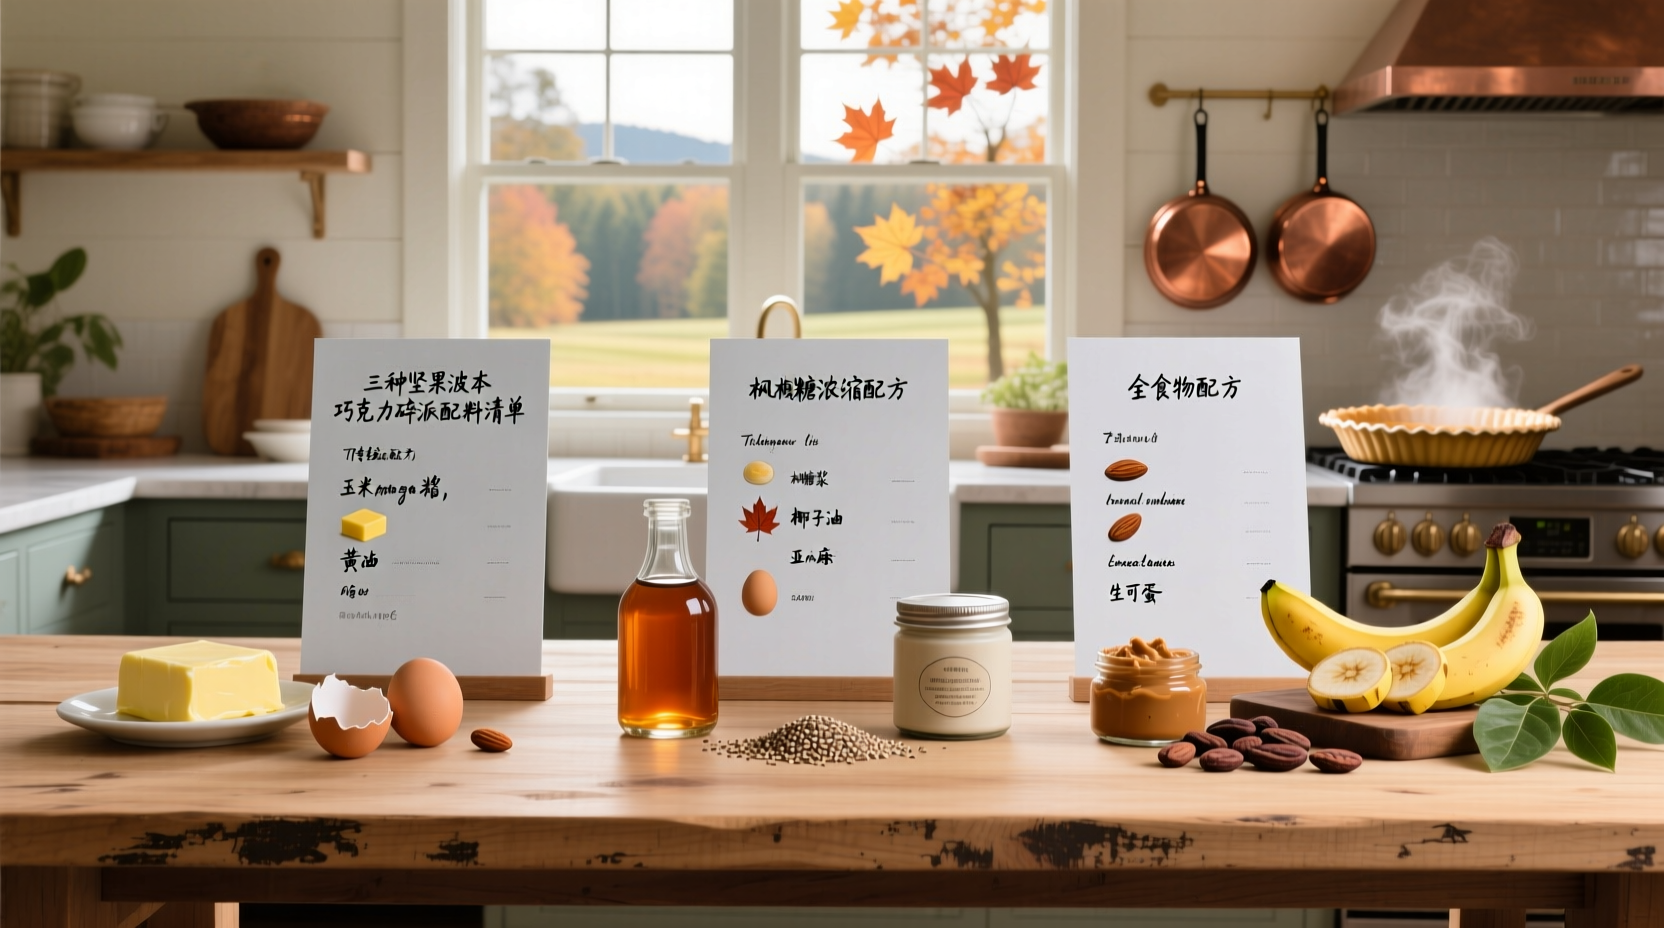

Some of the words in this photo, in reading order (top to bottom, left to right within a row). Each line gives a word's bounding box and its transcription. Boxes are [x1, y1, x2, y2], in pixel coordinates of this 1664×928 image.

[363, 370, 492, 397] 三种坚果波本
[1127, 373, 1242, 402] 全食物配方
[333, 395, 525, 425] 巧克力碎派配料清单
[790, 506, 843, 530] 椰子油
